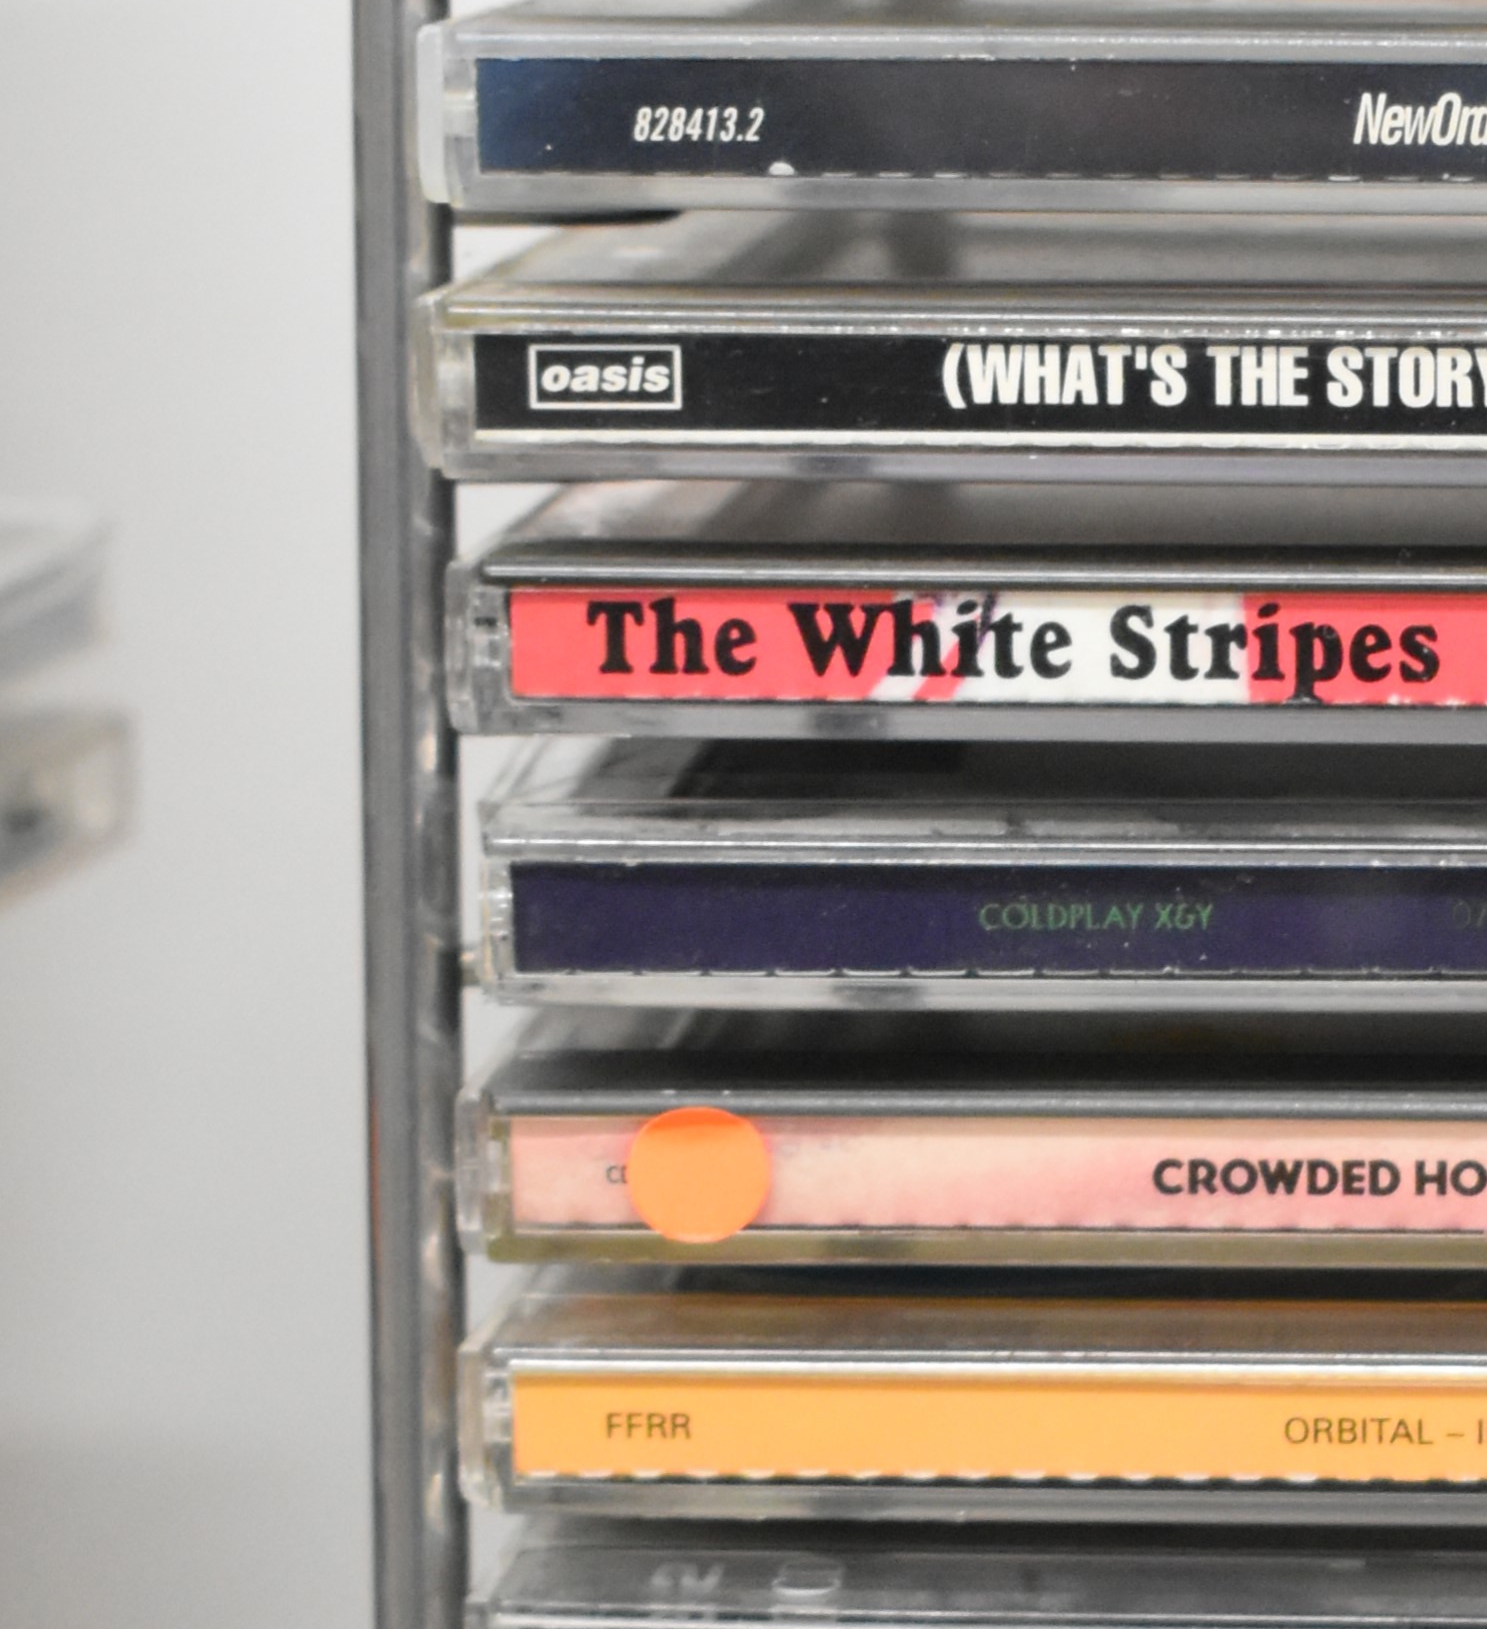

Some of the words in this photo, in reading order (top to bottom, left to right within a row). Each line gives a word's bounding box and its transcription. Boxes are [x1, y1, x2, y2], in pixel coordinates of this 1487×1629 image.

[633, 106, 764, 142] 828413.2
[541, 358, 672, 394] oasis
[943, 340, 1186, 411] (WHAT'S
[1208, 345, 1308, 406] THE
[587, 597, 757, 676] The
[789, 591, 1073, 678] White
[1109, 600, 1441, 701] Stripes
[979, 902, 1141, 931] COLDPLAY
[1153, 902, 1214, 932] X&Y
[1153, 1159, 1400, 1198] CROWDED
[605, 1413, 692, 1439] FFRR
[1284, 1417, 1433, 1446] ORBITAL
